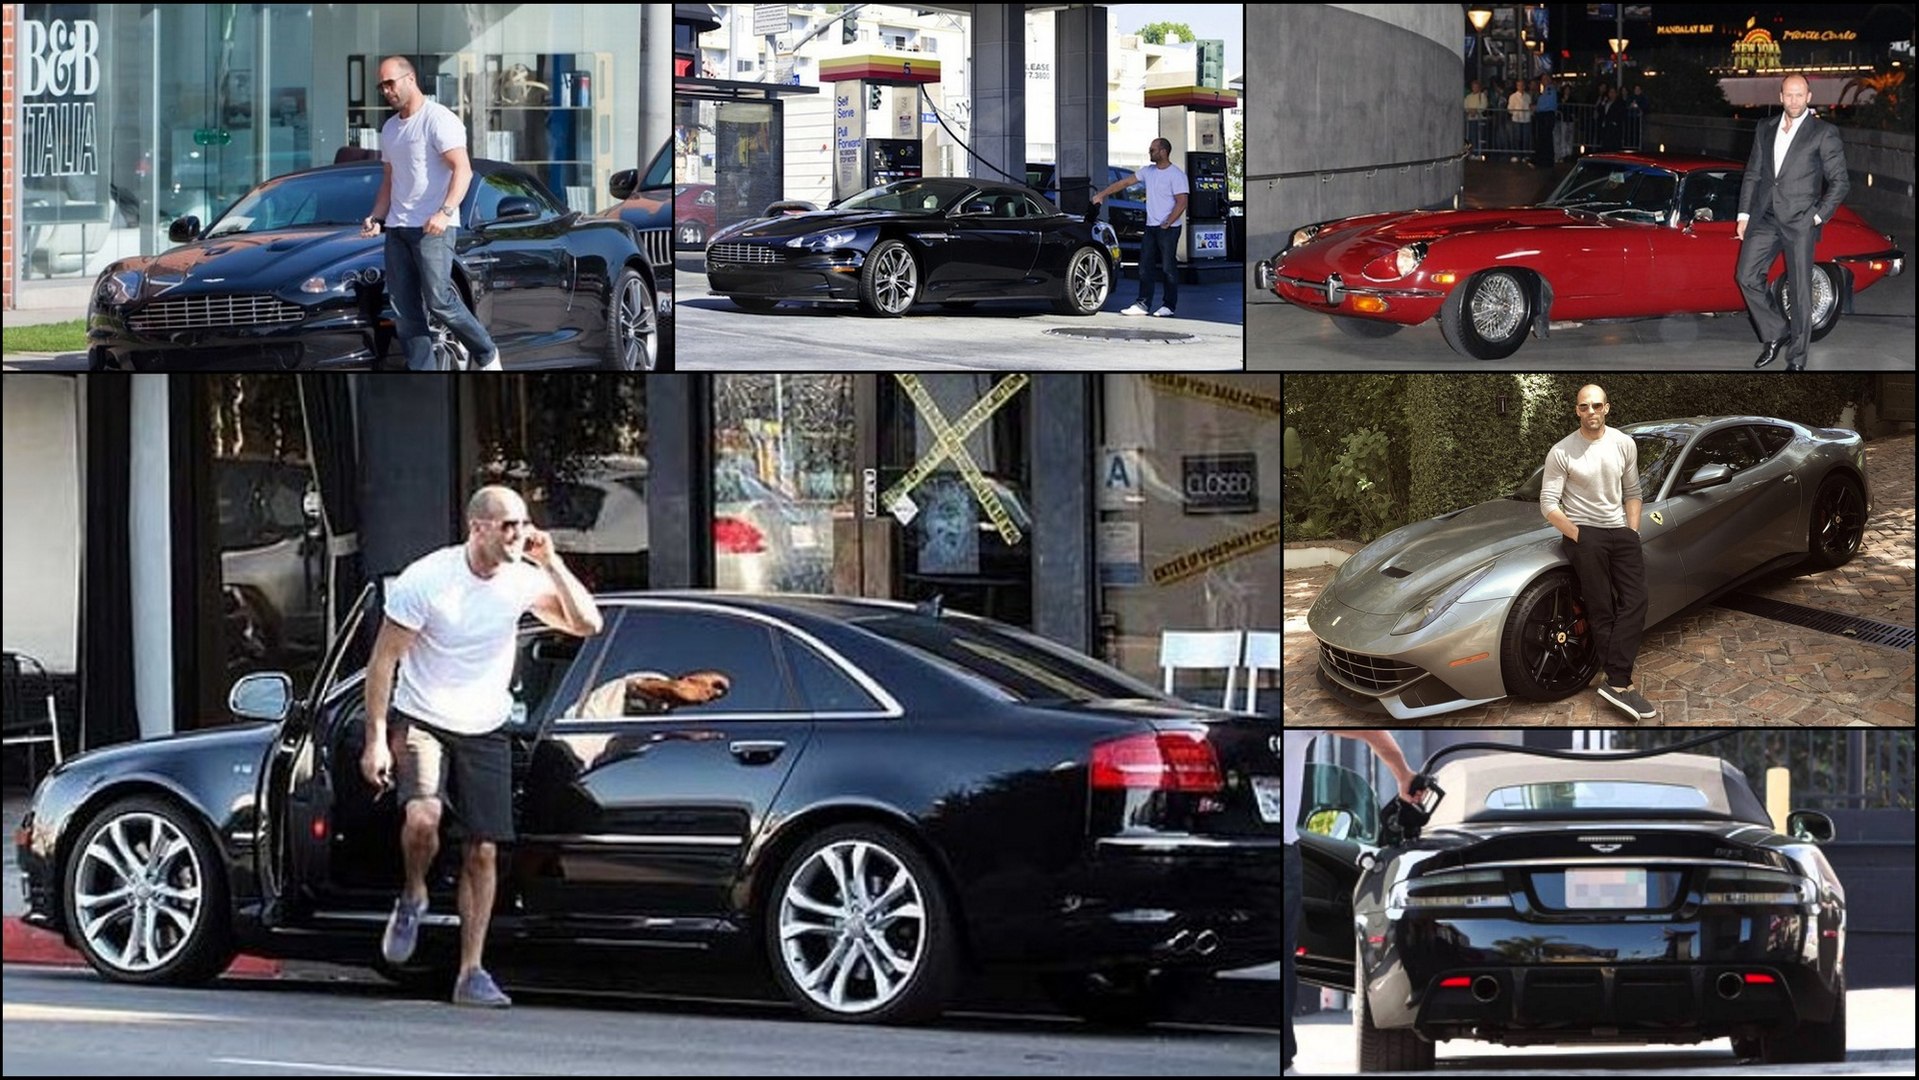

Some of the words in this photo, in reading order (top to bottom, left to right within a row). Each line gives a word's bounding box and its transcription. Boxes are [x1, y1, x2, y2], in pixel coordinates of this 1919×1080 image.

[1656, 25, 1698, 34] MANDALAY
[1699, 24, 1714, 33] BAY
[1782, 30, 1819, 40] Monte
[1820, 30, 1857, 40] Carlo
[1733, 41, 1755, 53] NEW
[1756, 41, 1780, 53] YORK
[23, 19, 100, 97] B&B
[903, 62, 912, 75] 5
[837, 96, 849, 106] Self
[837, 108, 855, 118] Serve
[837, 127, 848, 137] Pull
[23, 103, 99, 178] ITALIA
[838, 138, 861, 149] Forward
[1207, 241, 1219, 249] OIL
[1106, 456, 1130, 488] A
[1188, 472, 1251, 495] CLOSED
